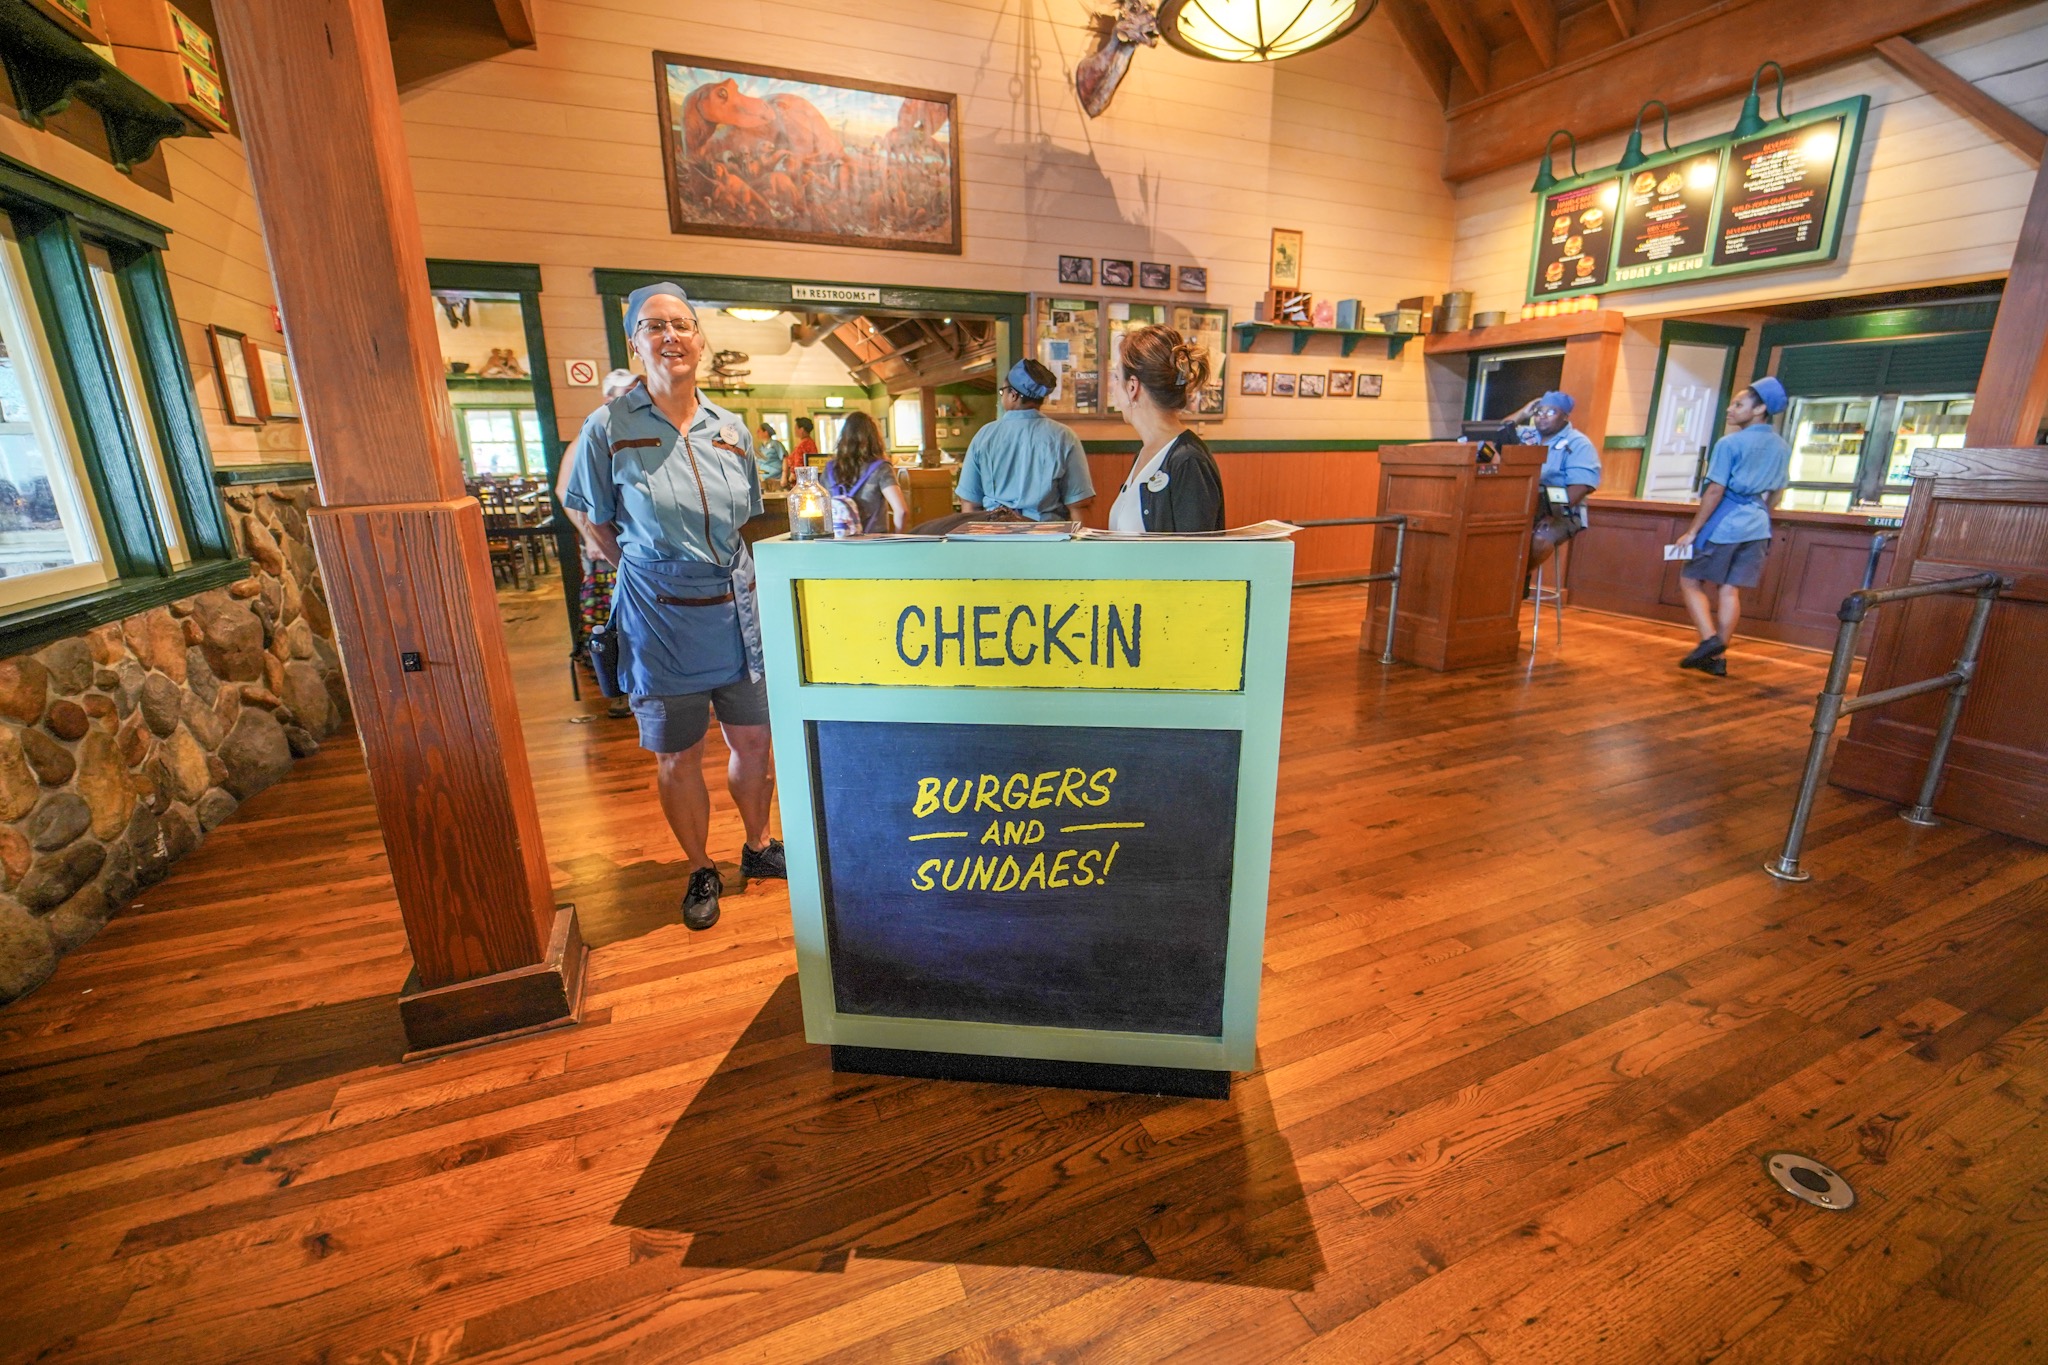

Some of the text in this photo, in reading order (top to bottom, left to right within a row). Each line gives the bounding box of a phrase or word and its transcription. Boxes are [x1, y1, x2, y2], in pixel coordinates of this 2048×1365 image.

[1615, 263, 1663, 281] TODAY'S
[1667, 257, 1704, 273] MENU
[809, 289, 866, 300] RESTROOMS
[1874, 517, 1893, 526] EXIT
[896, 604, 1142, 669] CHECK-IN
[912, 767, 1118, 818] BURGERS
[980, 820, 1045, 846] AND
[911, 841, 1120, 892] SUNDAES!
